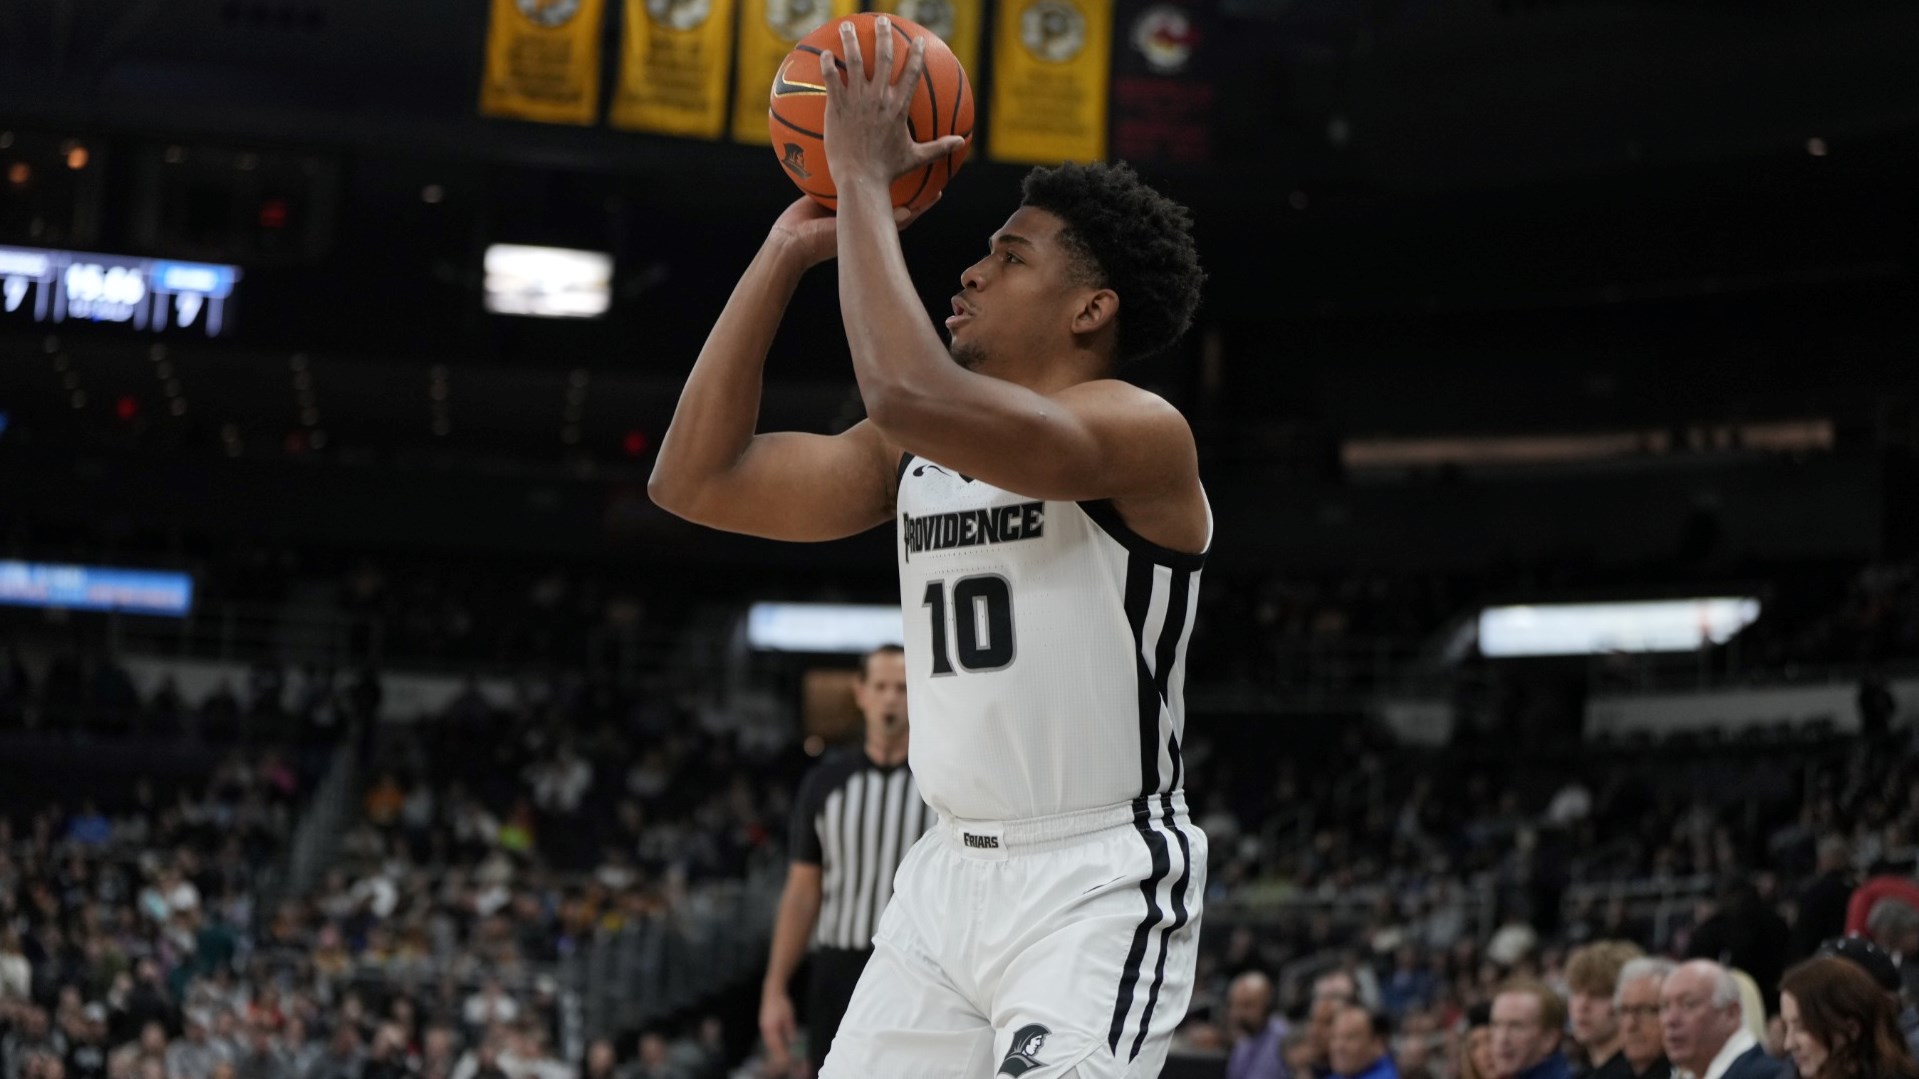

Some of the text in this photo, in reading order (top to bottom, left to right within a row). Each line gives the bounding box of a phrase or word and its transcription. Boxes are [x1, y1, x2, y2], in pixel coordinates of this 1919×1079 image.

[902, 501, 1046, 563] PROVIDENCE
[921, 572, 1018, 679] 10
[963, 832, 999, 849] FRIARS
